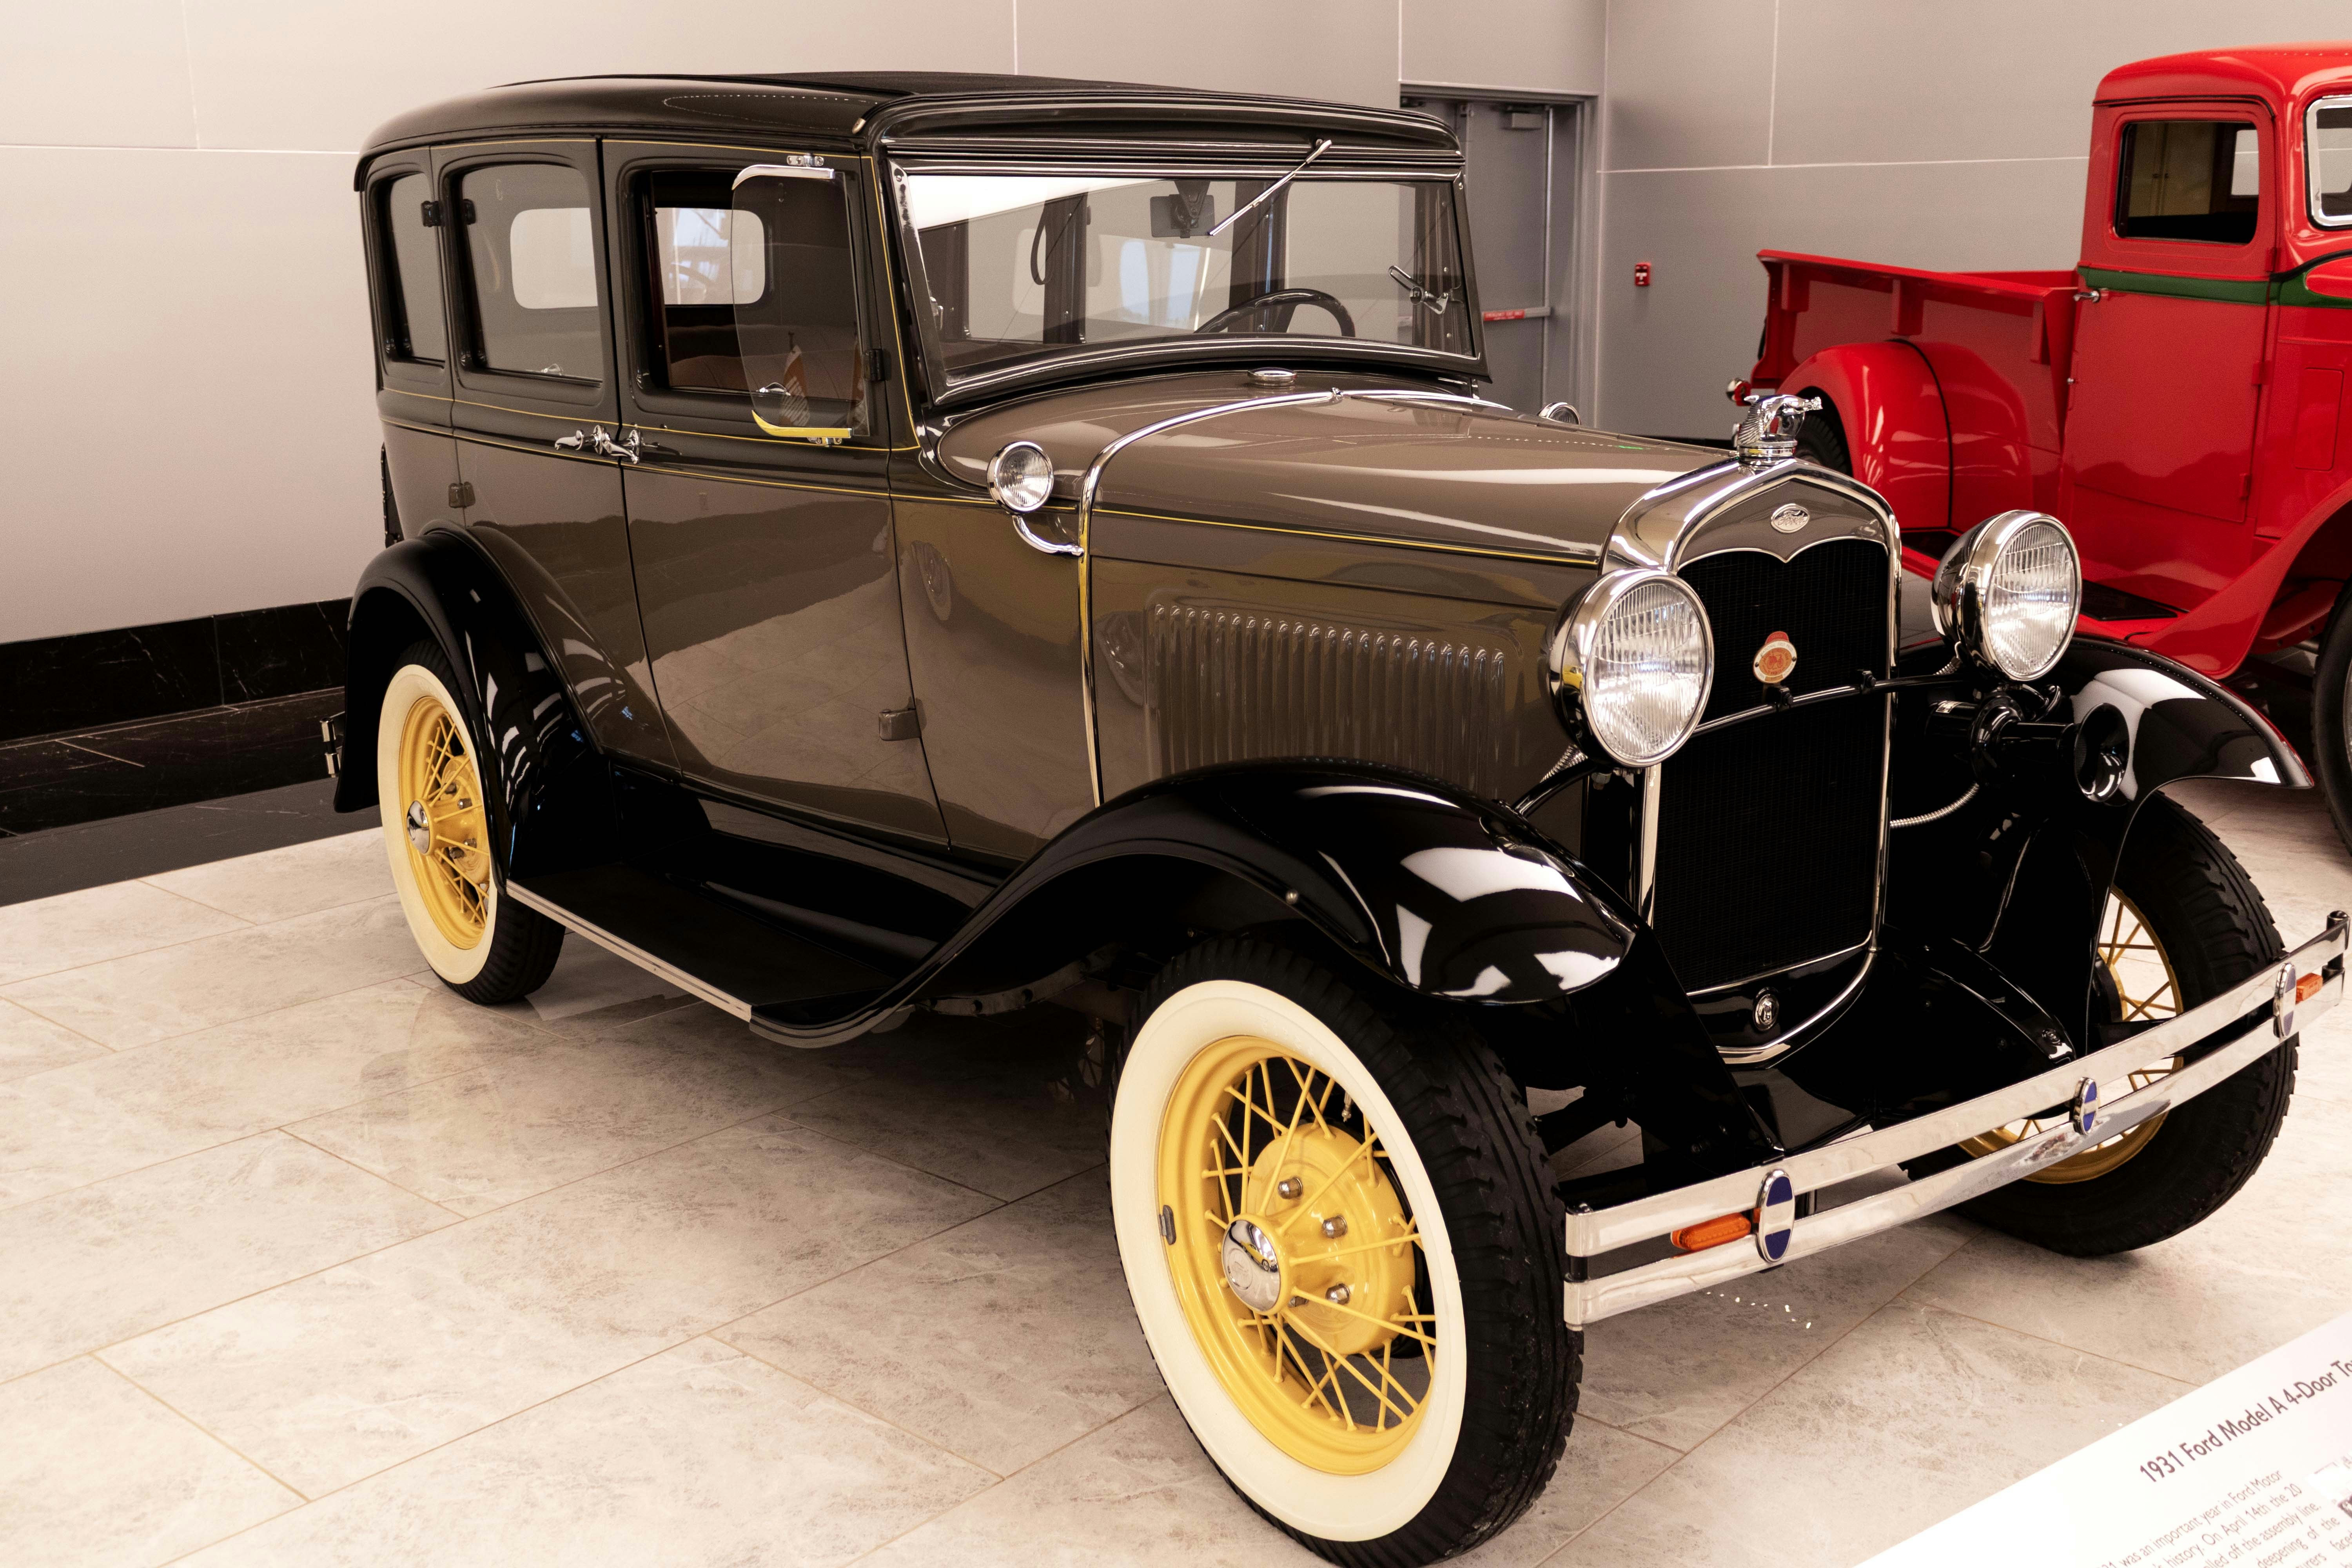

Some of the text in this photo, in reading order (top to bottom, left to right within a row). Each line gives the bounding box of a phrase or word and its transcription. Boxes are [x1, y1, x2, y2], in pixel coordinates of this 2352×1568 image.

[2140, 1360, 2352, 1482] 1931 Ford Model A 4-Door To
[2119, 1470, 2283, 1567] was an important year in Ford Motor
[2163, 1483, 2302, 1568] history. On April 14th the 20
[2229, 1544, 2244, 1559] off
[2242, 1537, 2261, 1550] the
[2259, 1513, 2303, 1541] assembly
[2296, 1503, 2321, 1517] line.
[2256, 1517, 2340, 1568] deepening of the
